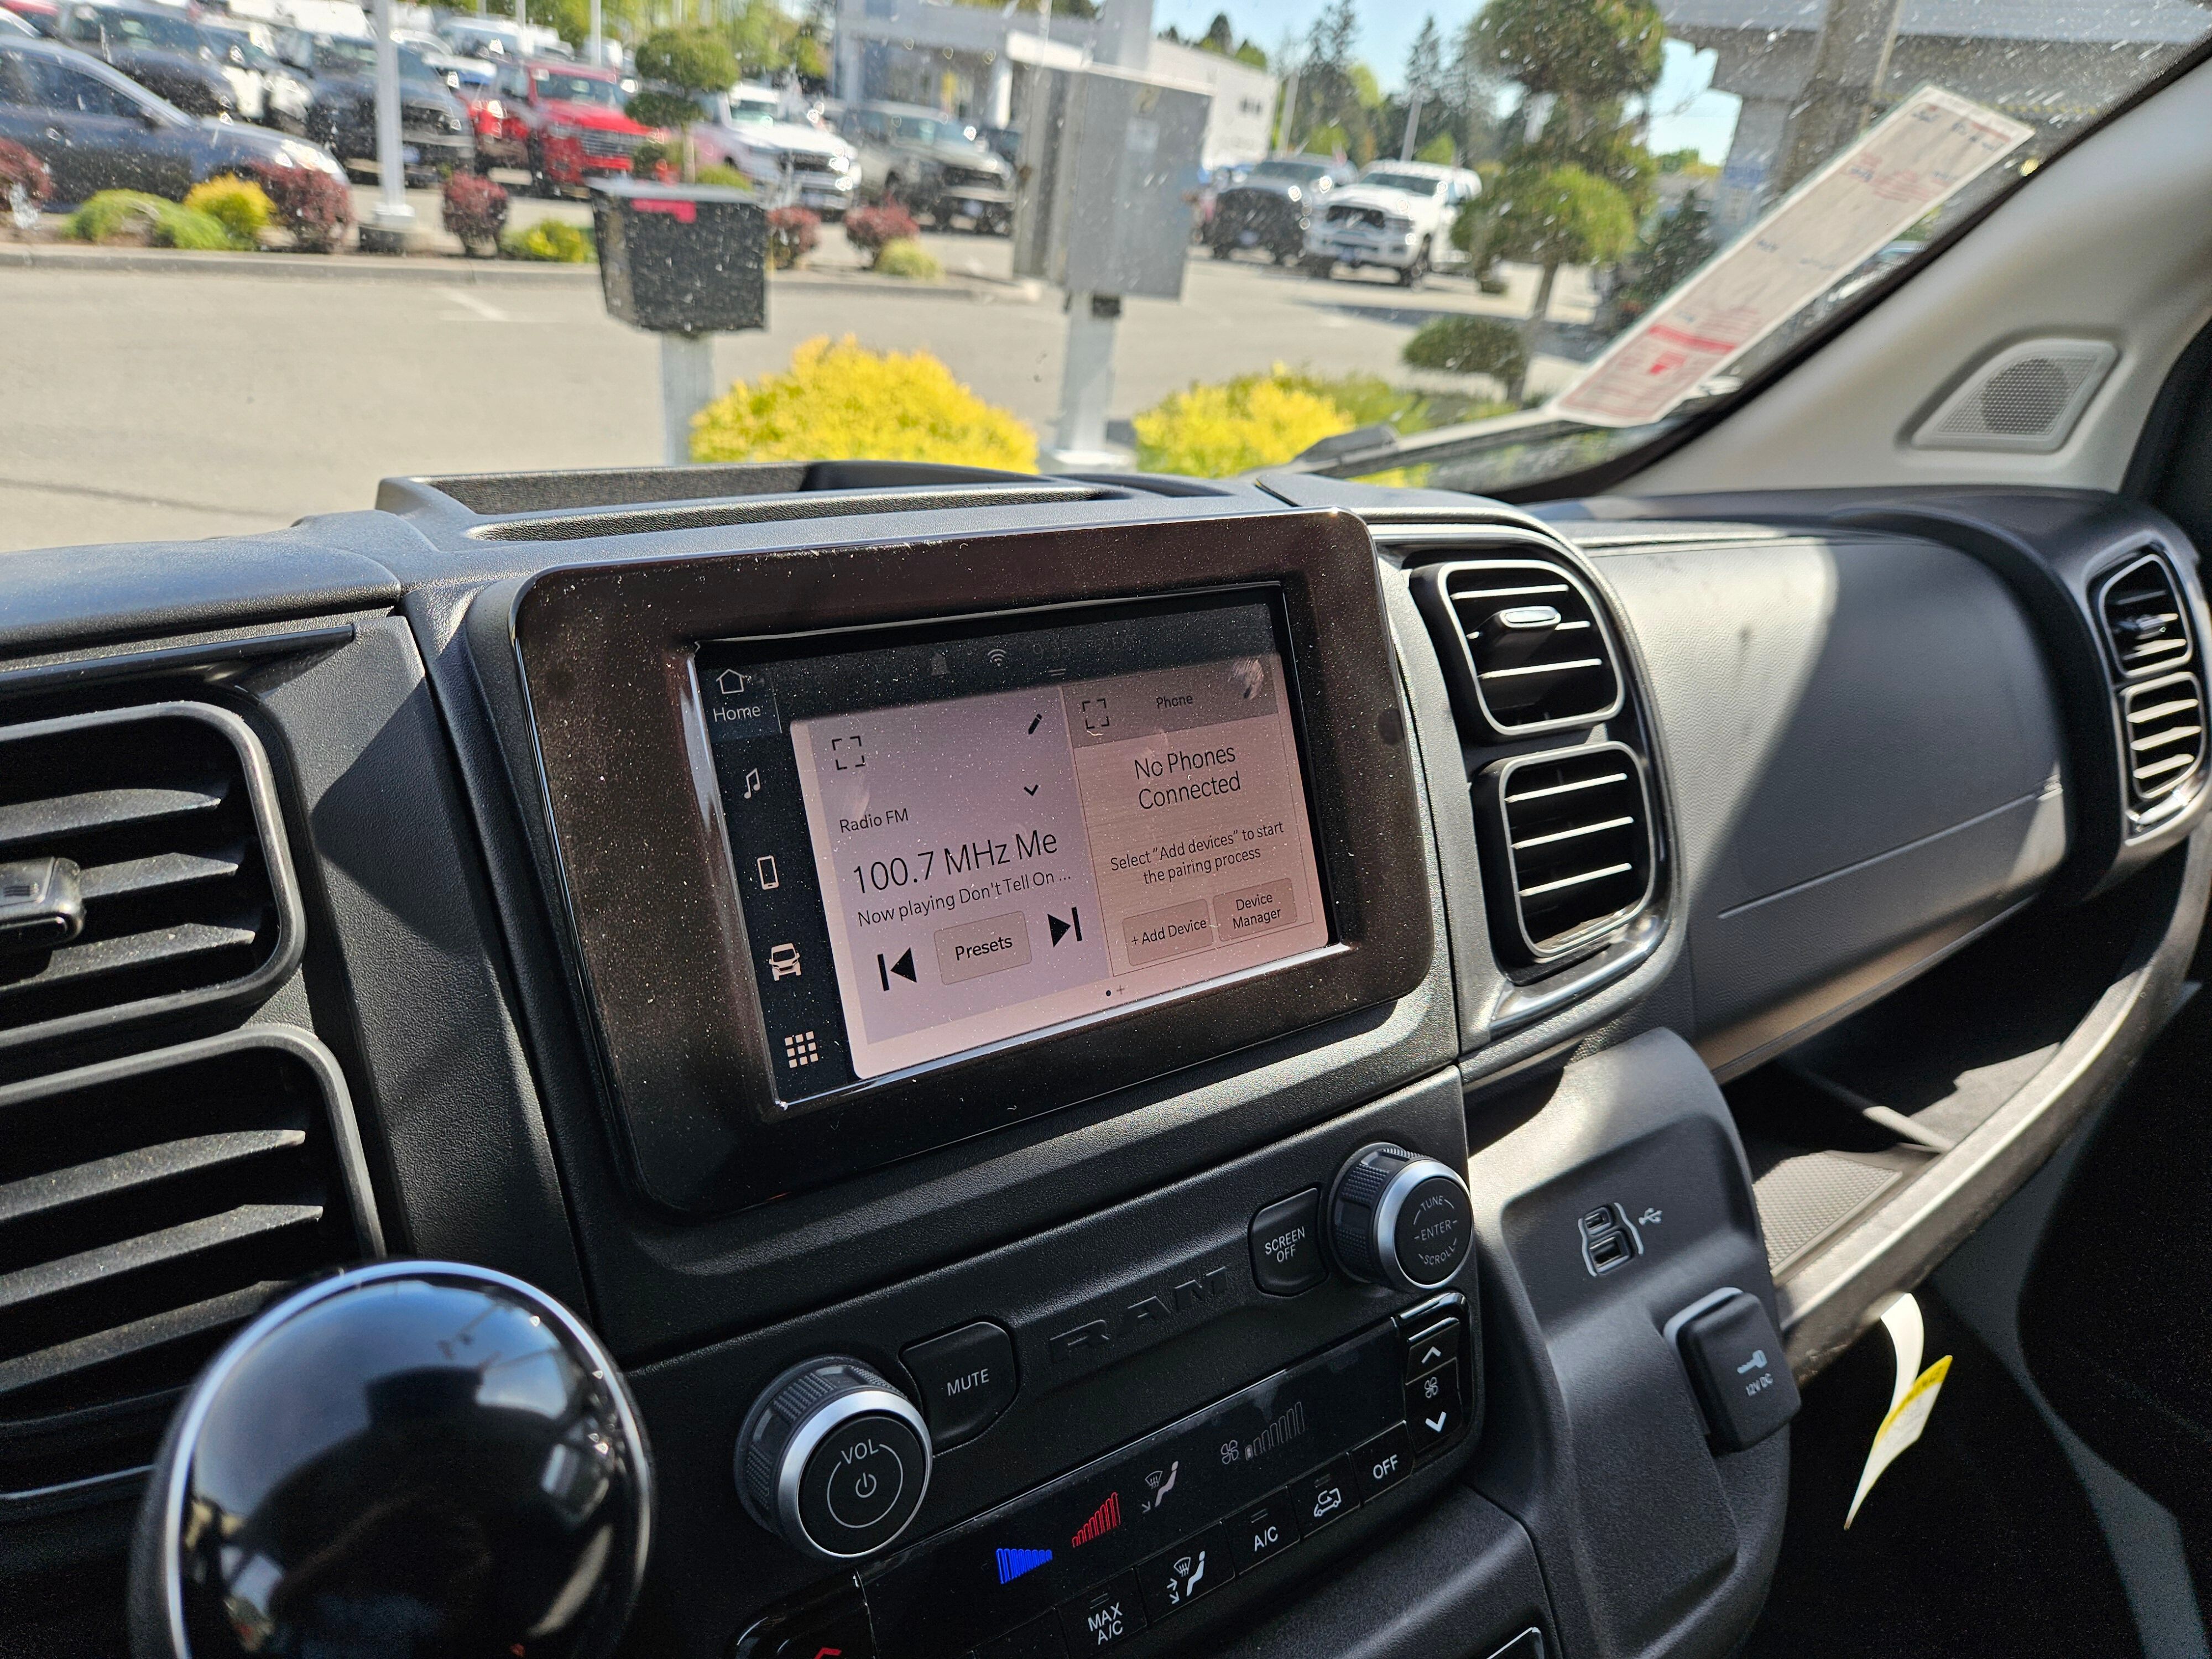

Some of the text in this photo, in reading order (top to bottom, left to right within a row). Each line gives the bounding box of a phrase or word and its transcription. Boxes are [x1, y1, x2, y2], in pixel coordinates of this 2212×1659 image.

[713, 705, 761, 722] Home
[1156, 695, 1193, 709] Phone
[1135, 747, 1236, 780] No Phones
[1139, 771, 1241, 809] Connected
[839, 808, 909, 833] Radio FM
[1110, 851, 1152, 871] Select
[1242, 828, 1254, 841] to
[1257, 821, 1284, 838] start
[853, 830, 1057, 894] 100.7 MHz Me
[1143, 847, 1261, 885] the pairing process
[858, 908, 894, 927] Now
[899, 894, 955, 921] playing
[960, 883, 1001, 904] Don't
[1003, 874, 1029, 893] Tell
[1033, 871, 1054, 886] On
[1236, 893, 1273, 911] Device
[1142, 928, 1165, 945] Add
[1168, 918, 1207, 937] Device
[1233, 907, 1281, 930] Manager
[955, 936, 1013, 961] Presets
[1420, 1195, 1444, 1212] TUNE
[1264, 1226, 1306, 1255] SCREEN
[1420, 1219, 1452, 1241] ENTER
[1276, 1245, 1296, 1263] OFF
[1423, 1245, 1455, 1266] SCROLL
[1049, 1266, 1228, 1363] RAM
[946, 1368, 990, 1396] MUTE
[841, 1438, 879, 1465] VOL
[1373, 1454, 1399, 1480] OFF
[1253, 1526, 1279, 1552] A/C
[1088, 1603, 1123, 1632] MAX
[1097, 1620, 1124, 1646] A/C
